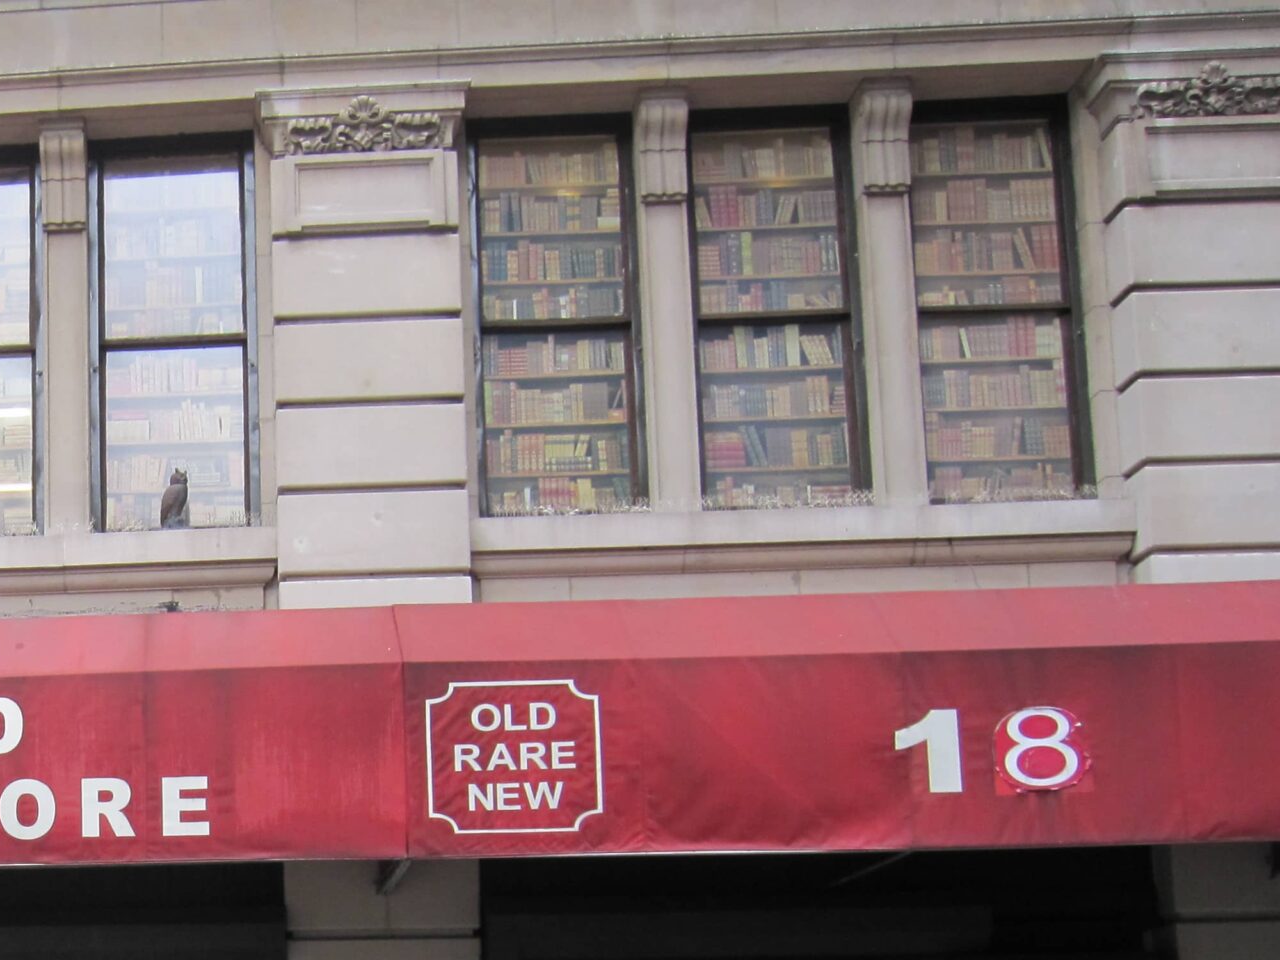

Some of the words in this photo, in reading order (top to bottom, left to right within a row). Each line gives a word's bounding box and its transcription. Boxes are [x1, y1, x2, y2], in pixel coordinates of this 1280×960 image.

[470, 702, 557, 732] OLD
[453, 740, 577, 772] RARE
[467, 780, 564, 813] NEW
